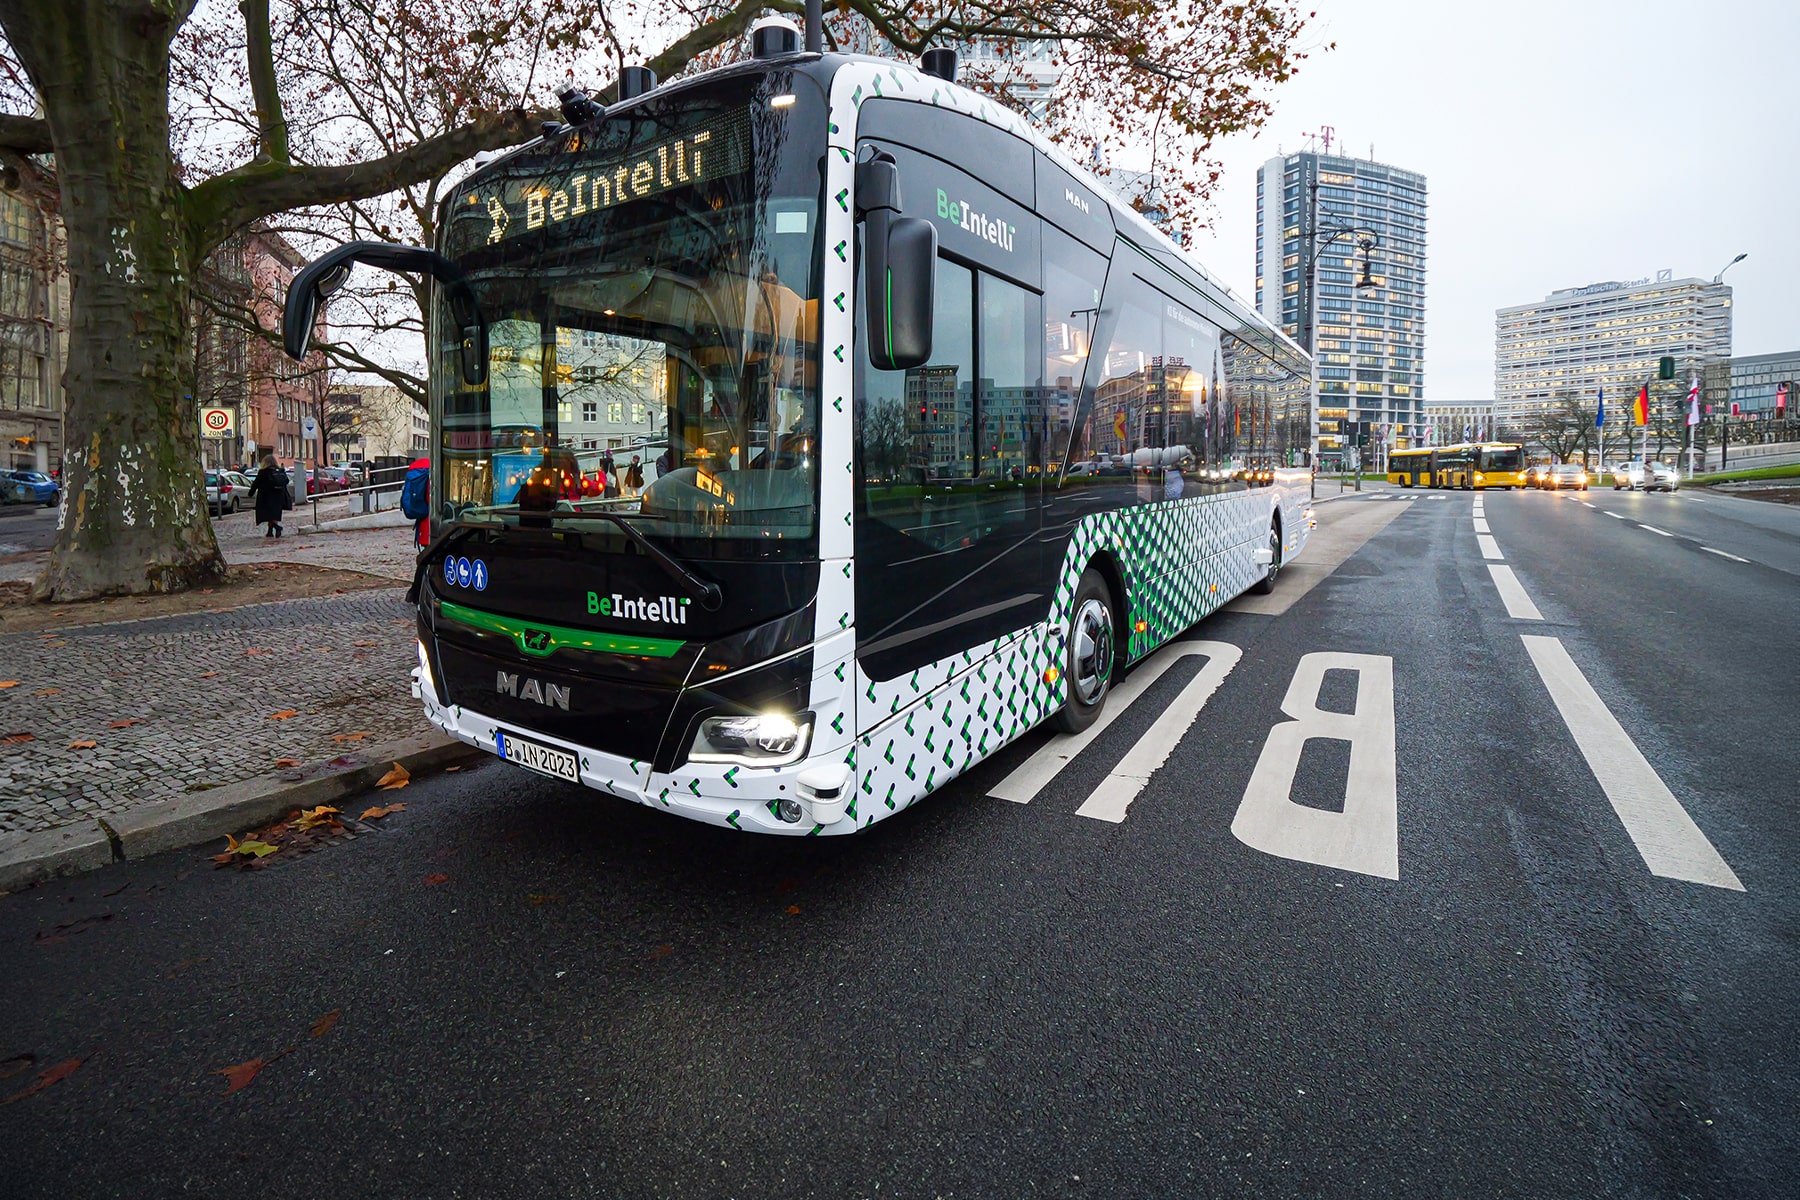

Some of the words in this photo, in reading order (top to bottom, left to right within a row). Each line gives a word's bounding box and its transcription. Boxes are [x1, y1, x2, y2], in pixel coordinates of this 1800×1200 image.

[527, 130, 710, 230] BeIntelli
[1065, 187, 1089, 214] MAN
[936, 187, 1016, 252] BeIntelli
[210, 416, 224, 425] 30
[586, 591, 692, 625] BeIntelli
[496, 670, 571, 712] MAN
[504, 738, 513, 758] B
[540, 750, 575, 778] 2023
[986, 640, 1399, 881] BU
